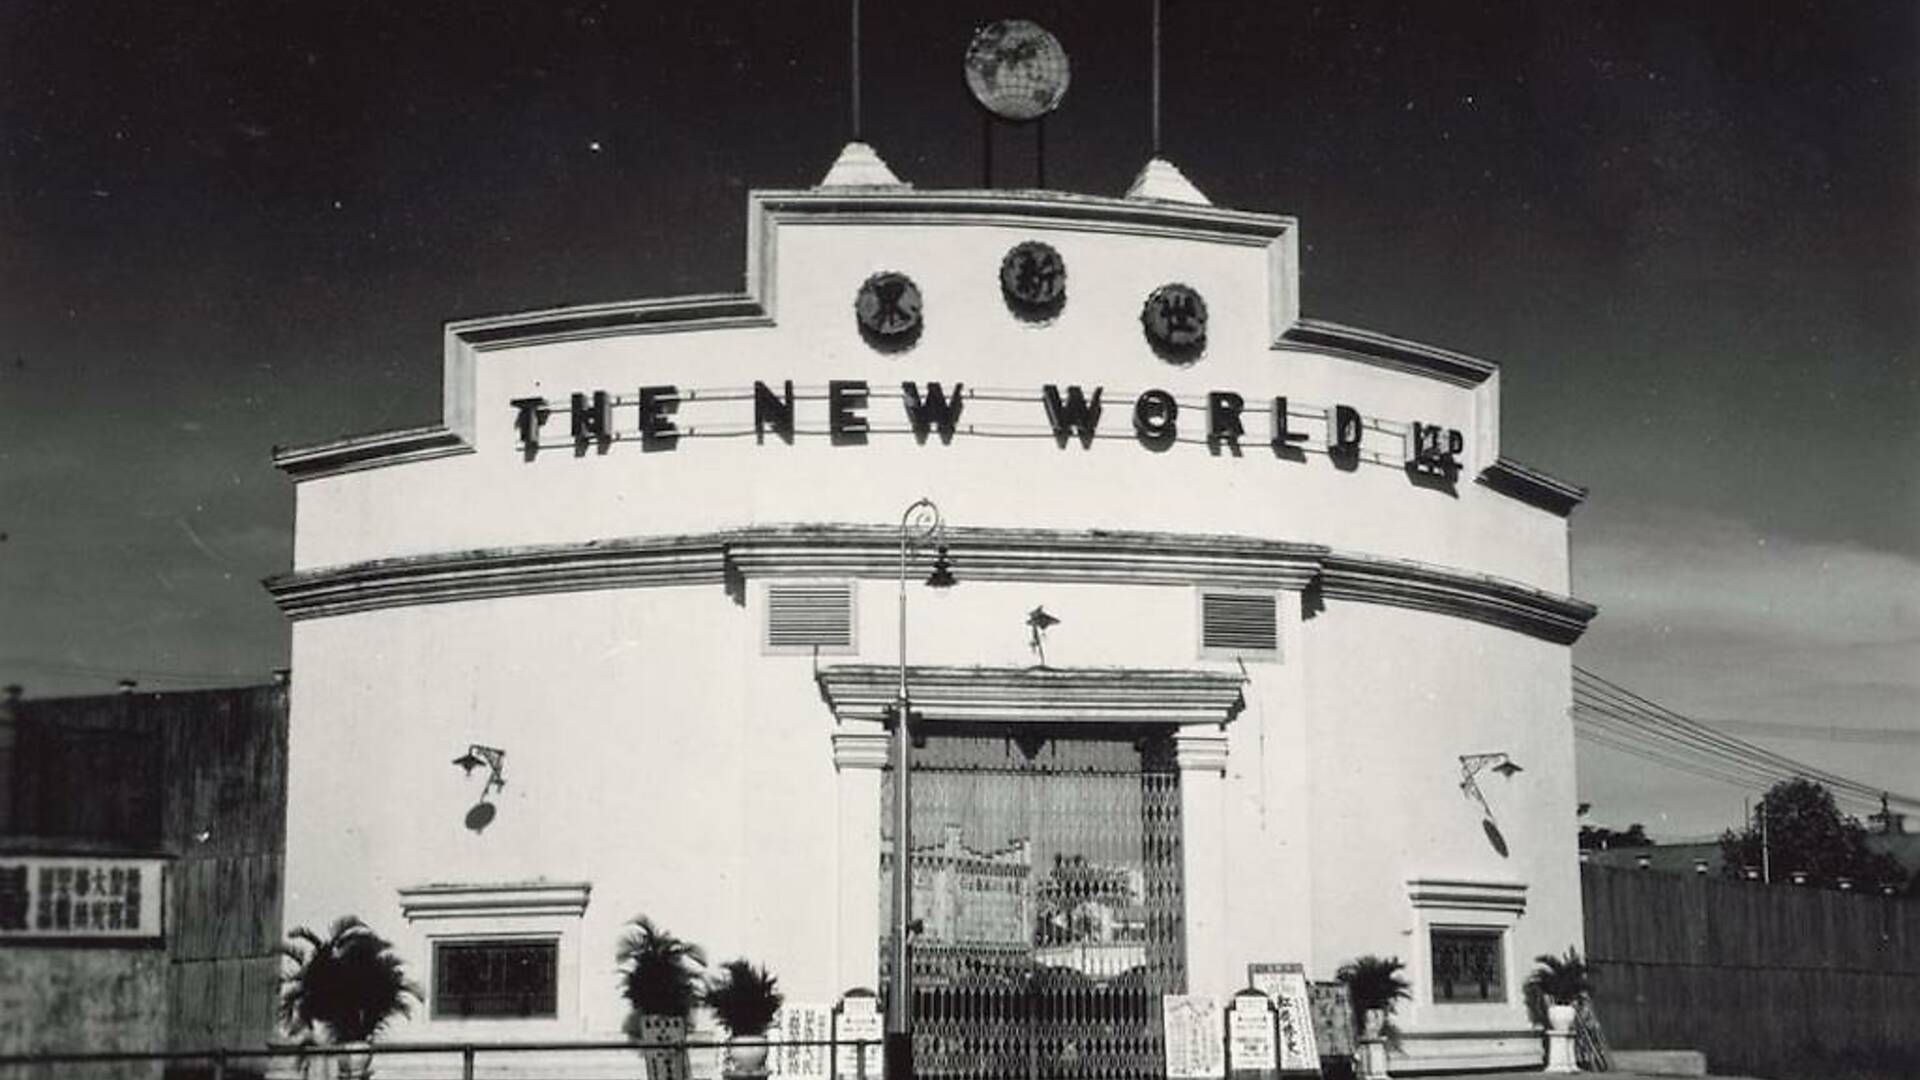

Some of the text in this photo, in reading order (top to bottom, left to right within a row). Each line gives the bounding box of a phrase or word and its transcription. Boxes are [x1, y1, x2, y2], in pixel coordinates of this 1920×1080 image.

[509, 384, 680, 452] THE
[753, 380, 965, 445] NEW
[1042, 384, 1364, 458] WORLD
